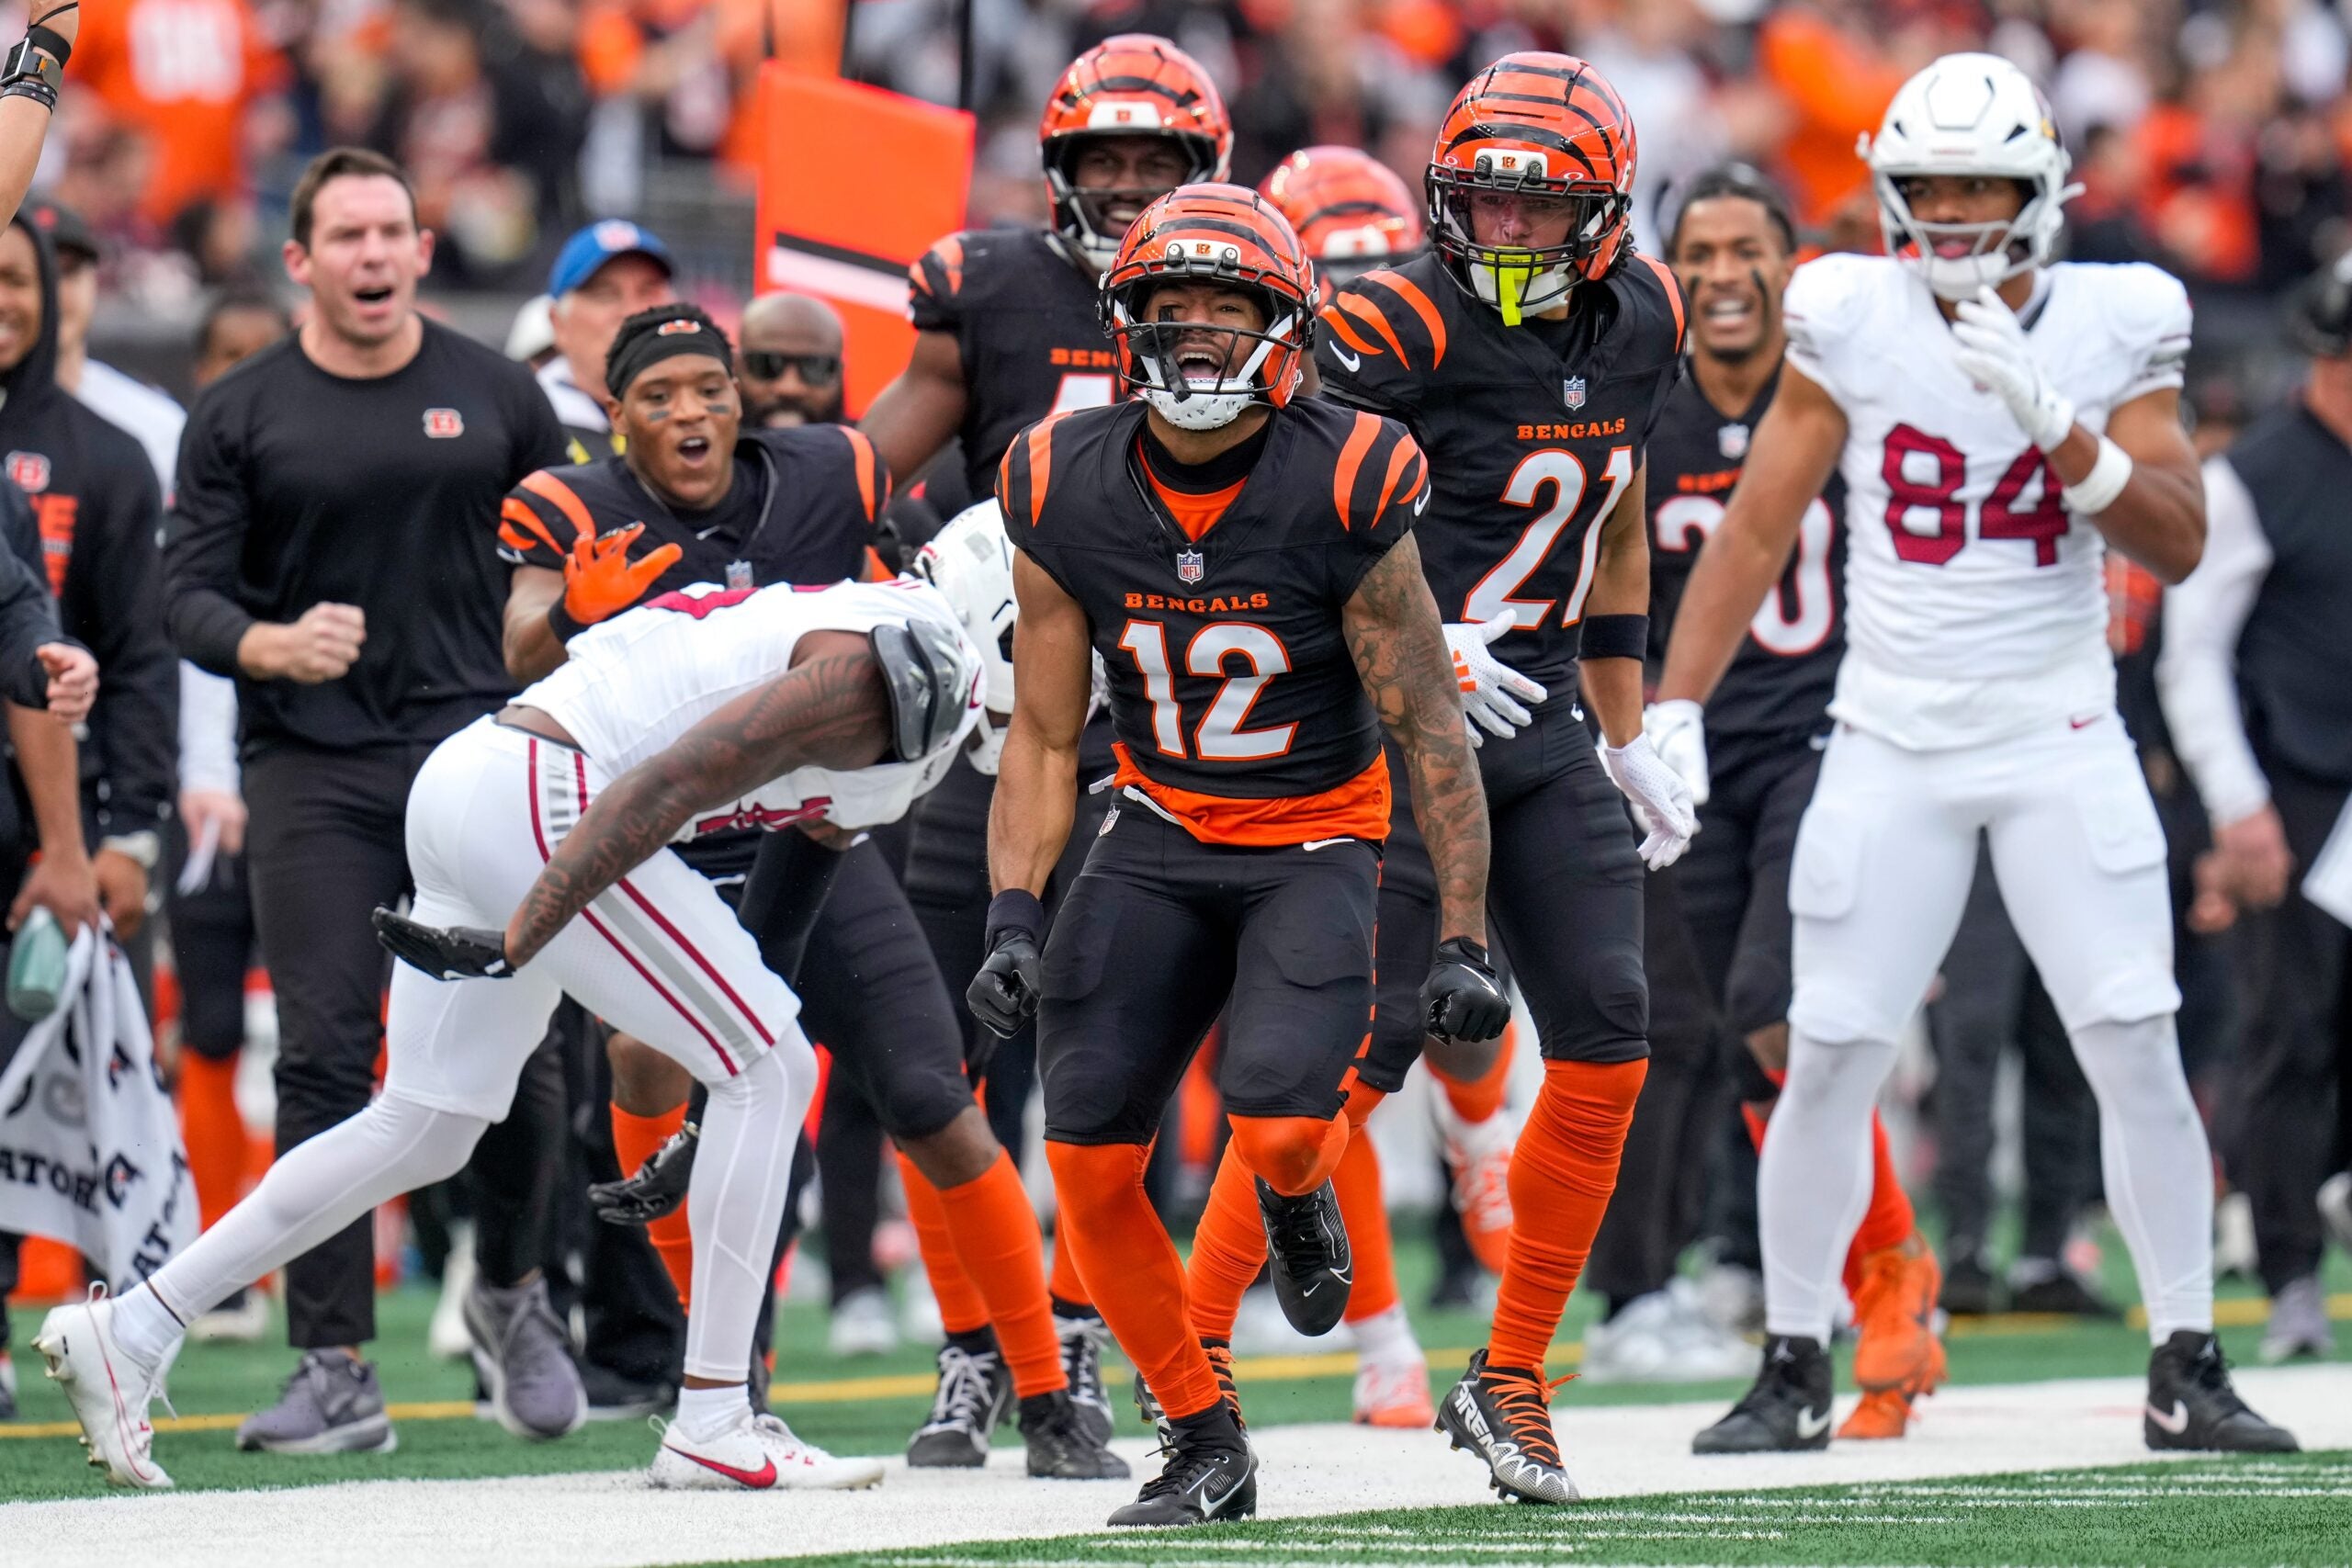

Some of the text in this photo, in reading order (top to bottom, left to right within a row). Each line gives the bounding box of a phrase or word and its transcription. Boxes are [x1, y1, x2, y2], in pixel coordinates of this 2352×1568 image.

[1517, 418, 1625, 440] BENGALS
[30, 493, 79, 540] E
[1460, 445, 1634, 631] 21
[1881, 422, 2070, 568] 84
[1125, 592, 1269, 614] BENGALS
[1117, 618, 1299, 761] 12
